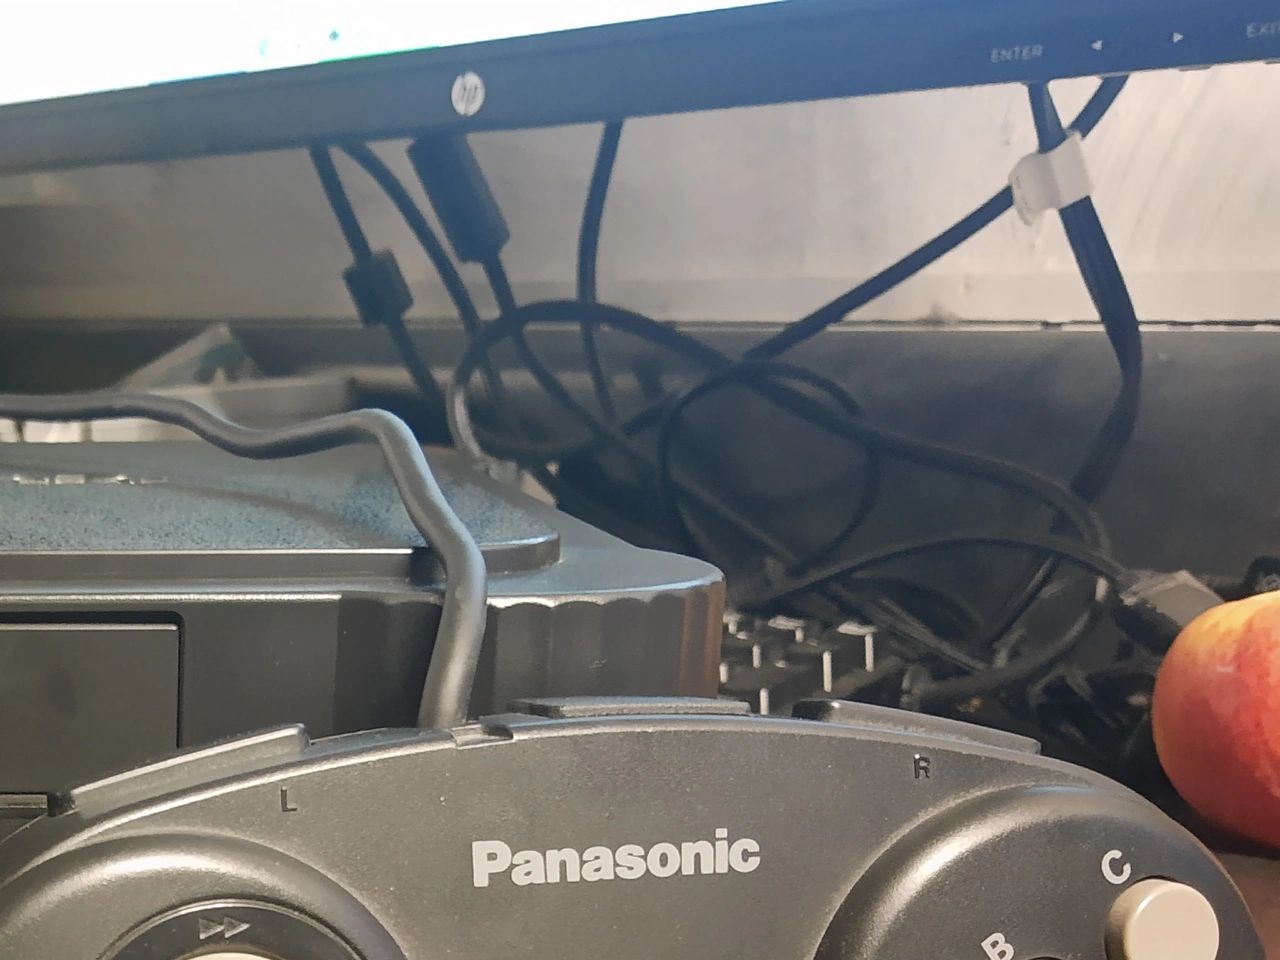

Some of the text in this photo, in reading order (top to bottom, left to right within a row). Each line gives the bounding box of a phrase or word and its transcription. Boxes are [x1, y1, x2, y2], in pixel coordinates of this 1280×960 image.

[990, 44, 1043, 63] ENTER
[453, 71, 483, 117] hp
[913, 755, 930, 779] R
[280, 787, 298, 812] L
[472, 828, 761, 887] Panasonic
[1101, 850, 1131, 885] C
